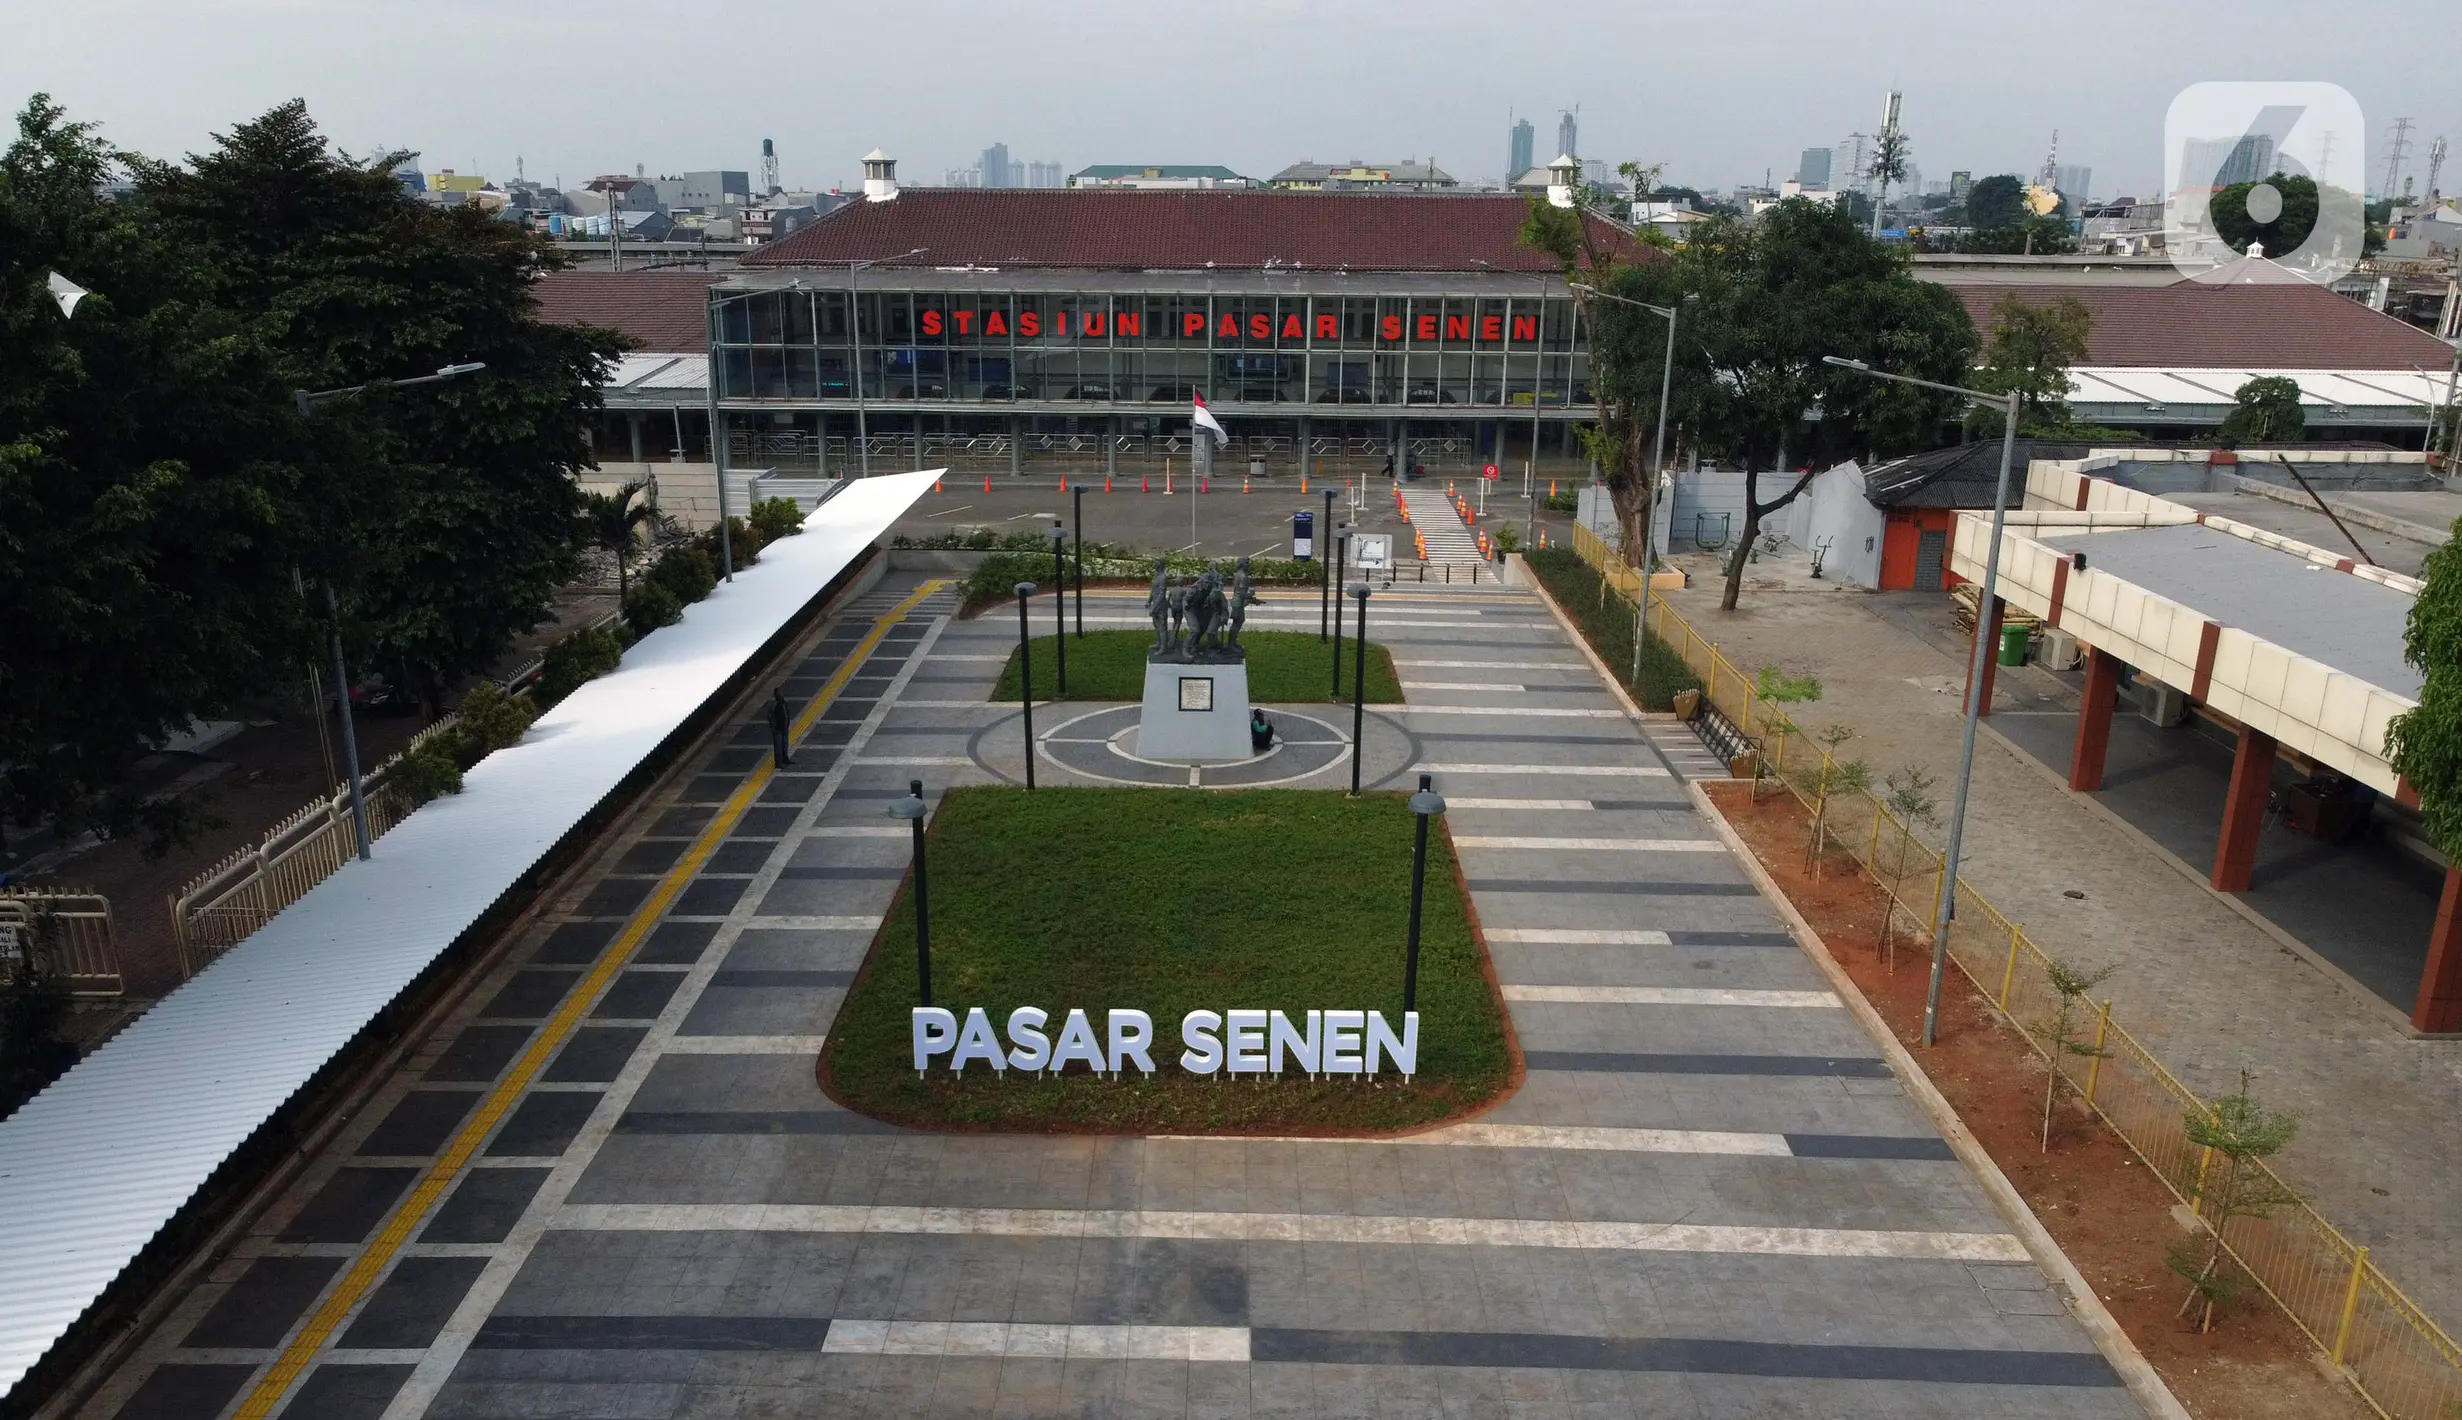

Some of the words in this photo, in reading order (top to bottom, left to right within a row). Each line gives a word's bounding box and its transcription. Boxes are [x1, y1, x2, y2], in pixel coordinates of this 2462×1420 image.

[922, 311, 1139, 337] STASIUN
[1184, 313, 1337, 339] PASAR
[1382, 315, 1536, 340] SENEN
[913, 1006, 1156, 1072] PASAR
[1180, 1009, 1420, 1075] SENEN
